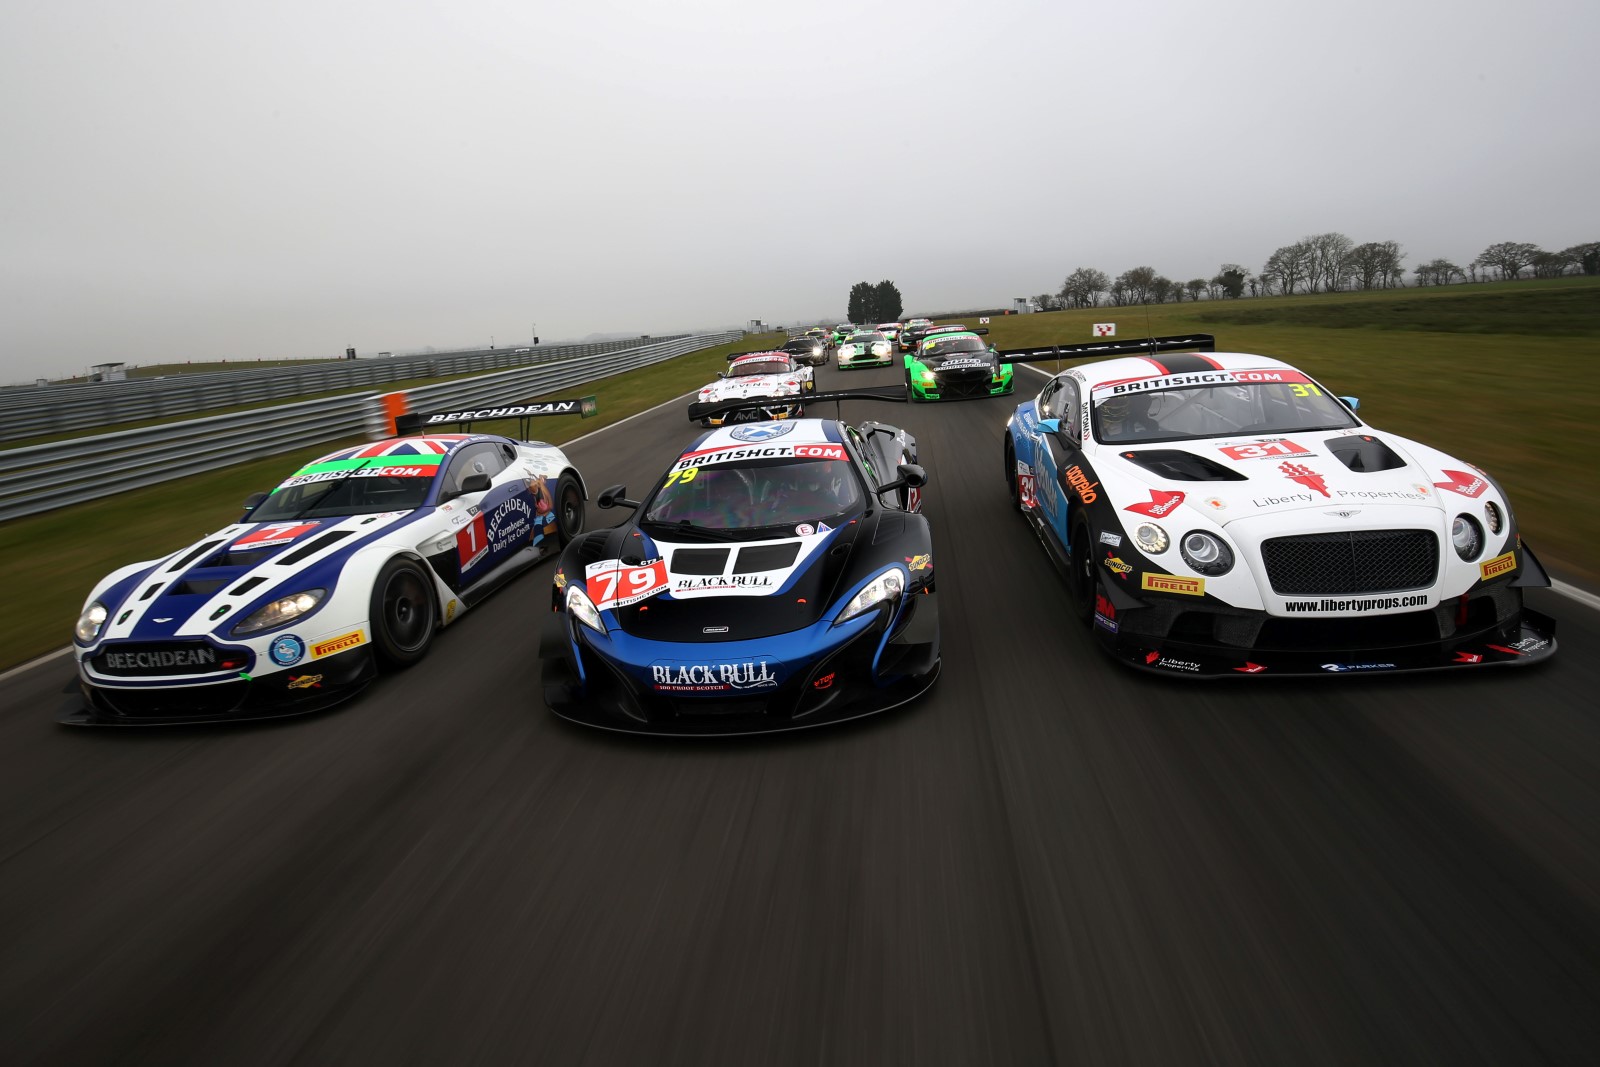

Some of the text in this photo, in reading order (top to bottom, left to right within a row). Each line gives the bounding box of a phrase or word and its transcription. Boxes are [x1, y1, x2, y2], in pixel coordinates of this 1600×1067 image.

[1113, 372, 1282, 394] BRITISHGT.COM
[1288, 383, 1322, 397] 31
[426, 401, 575, 423] BEECHDEAN
[1081, 401, 1090, 432] DAYTONA
[679, 447, 842, 469] BRITISHGT.COM
[1233, 444, 1290, 458] 31
[663, 468, 699, 488] 79
[1156, 495, 1180, 515] contact
[1253, 490, 1426, 507] Liberty Properties
[466, 522, 477, 552] 1
[498, 517, 525, 539] Farmhouse
[493, 539, 507, 553] Dairy
[507, 533, 516, 544] Ice
[1105, 558, 1132, 573] SUNOCO
[1484, 556, 1513, 576] PIRELLI
[595, 567, 656, 602] 79
[678, 575, 773, 588] BLACK BULL
[1147, 576, 1199, 593] PIRELLI
[1285, 594, 1428, 612] www.libertyprops.com
[315, 633, 360, 656] PIRELLI
[106, 649, 216, 669] BEECHDEAN
[1159, 661, 1199, 672] Properties
[1161, 658, 1201, 668] Liberty
[289, 674, 323, 690] SUNOCO
[652, 661, 775, 684] BLACK BULL
